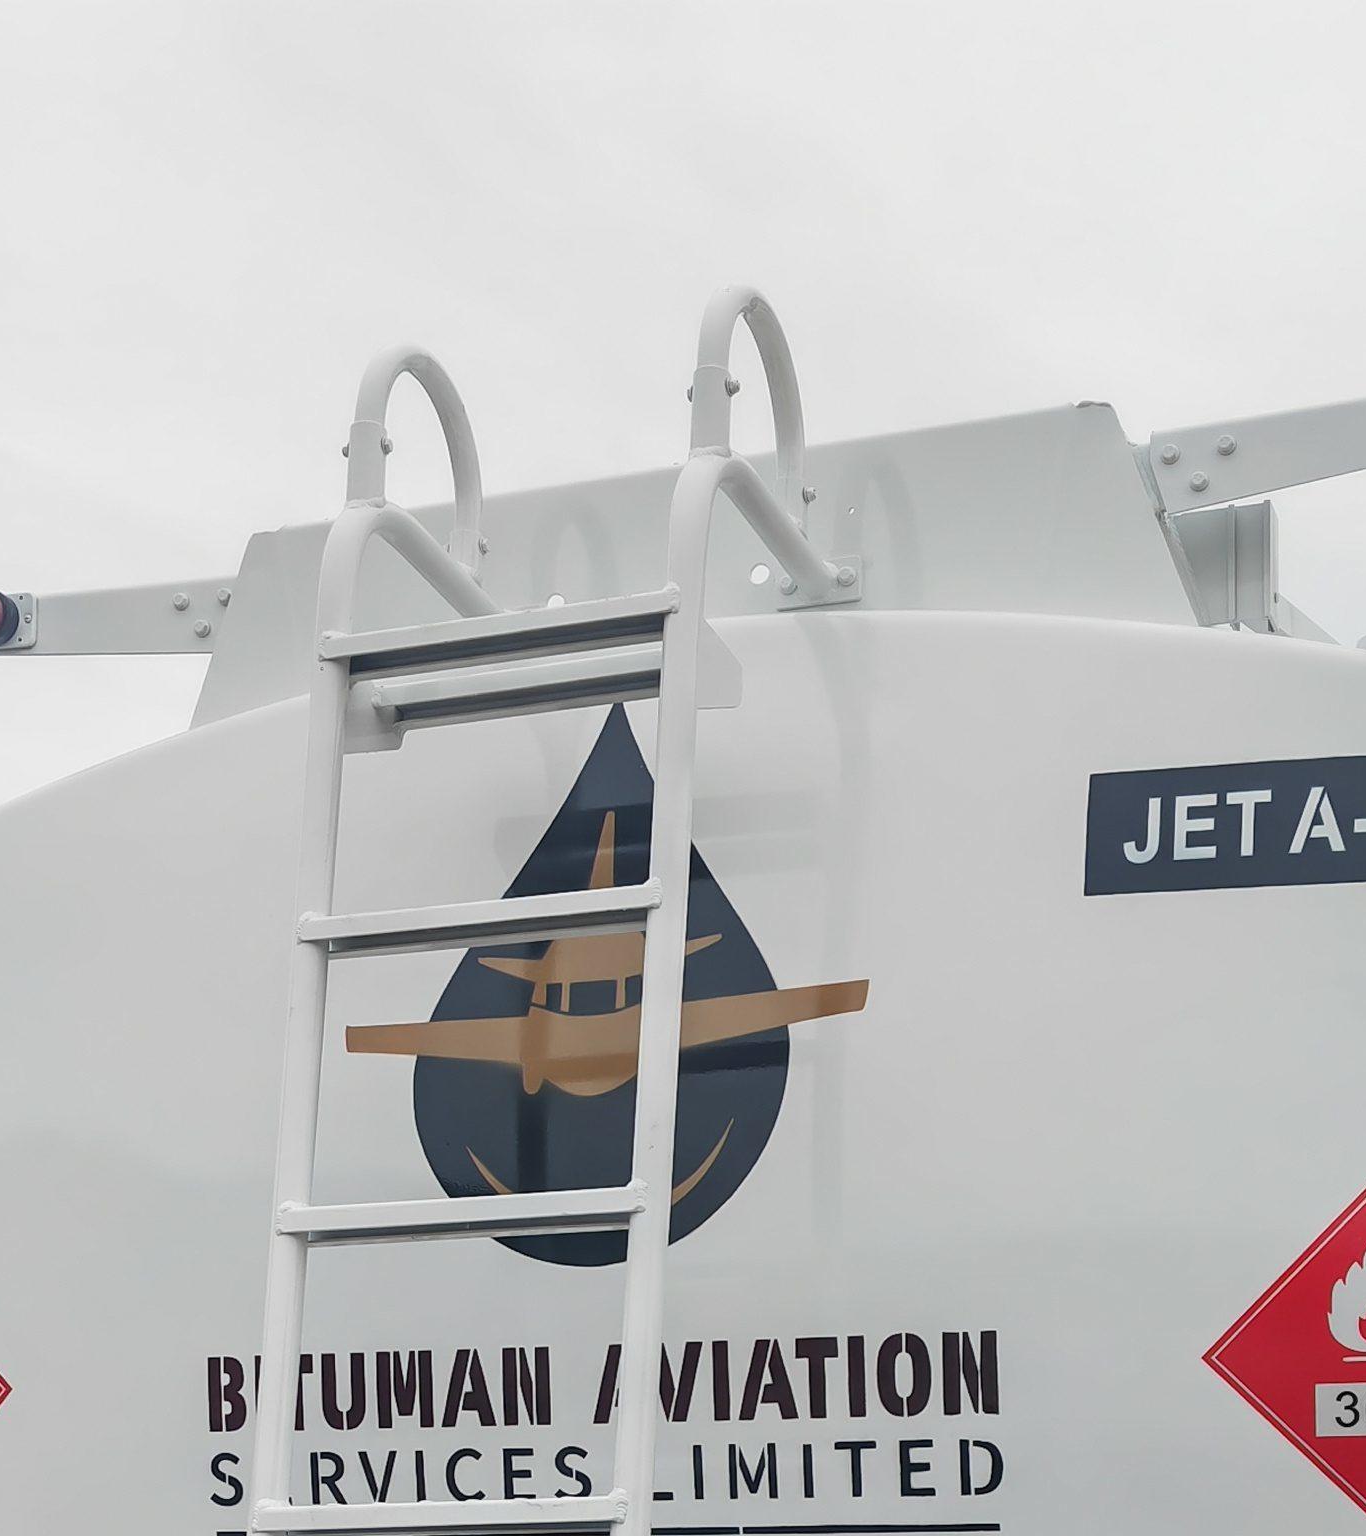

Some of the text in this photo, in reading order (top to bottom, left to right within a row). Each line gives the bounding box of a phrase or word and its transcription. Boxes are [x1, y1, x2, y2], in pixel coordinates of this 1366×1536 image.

[1123, 789, 1273, 864] JET
[207, 1346, 552, 1433] BUMAN
[210, 1446, 592, 1504] SRVICES
